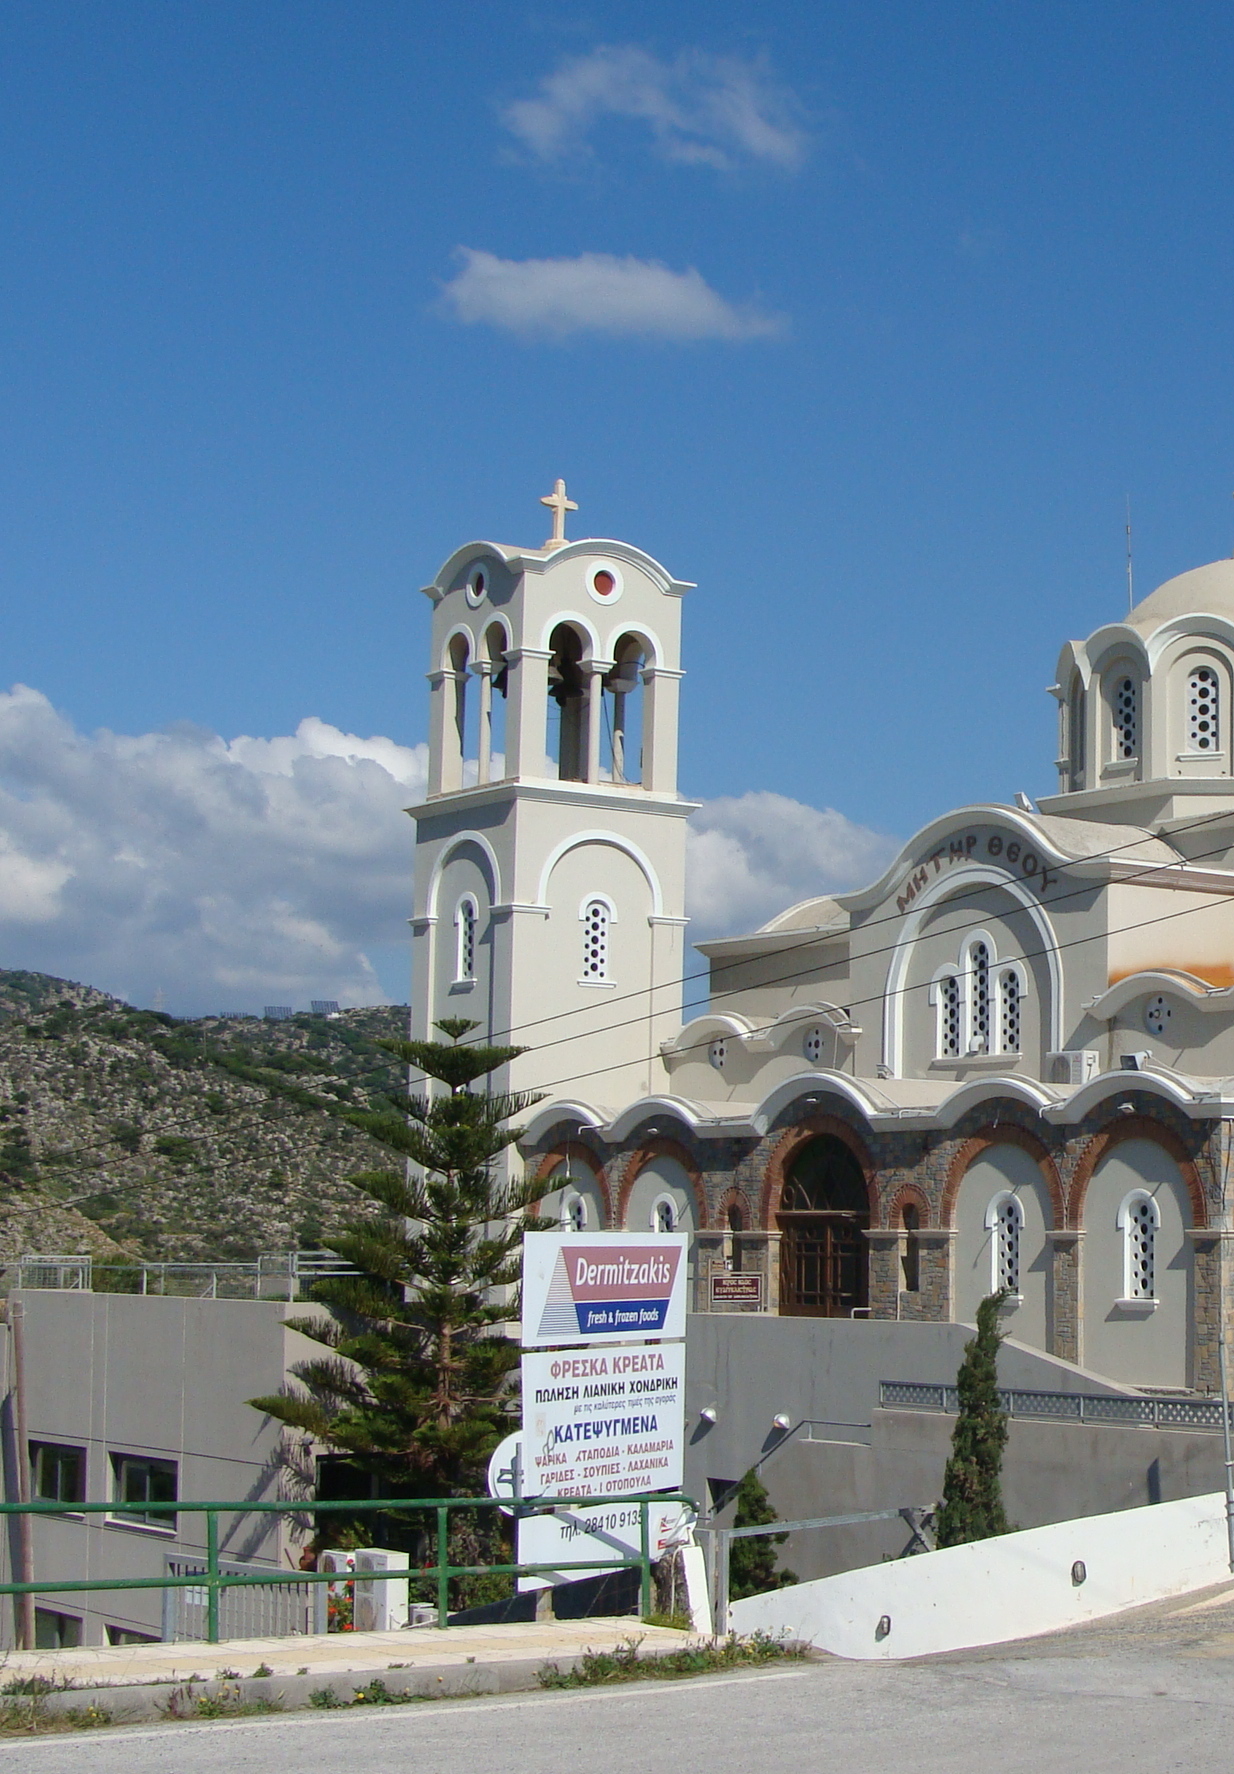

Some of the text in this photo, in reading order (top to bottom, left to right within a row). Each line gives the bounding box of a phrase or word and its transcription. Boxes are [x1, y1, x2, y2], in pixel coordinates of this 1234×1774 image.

[575, 1255, 671, 1286] Dermitzakis
[587, 1308, 659, 1328] fresh & frozen foods
[550, 1353, 665, 1380] ΦΡΕΣΚΑ ΚΡΕΑΤΑ
[535, 1376, 678, 1404] ΠΩΛΗΣΗ ΛΙΑΝΙΚΗ ΧΟΝΔΡΙΚΗ
[554, 1414, 658, 1444] ΚΑΤΕΨΥΓΜΕΝΑ
[627, 1439, 674, 1455] ΚΑΛΑΜΑΡΙΑ
[540, 1457, 669, 1485] ΓΑΡΙΔΕΣ ΣΟΥΠΙΕΣ ΛΑΧΑΝΙΚΑ
[557, 1483, 592, 1497] ΚΡΕΑΤΑ
[560, 1520, 581, 1542] τηλ.
[584, 1513, 617, 1534] 28410
